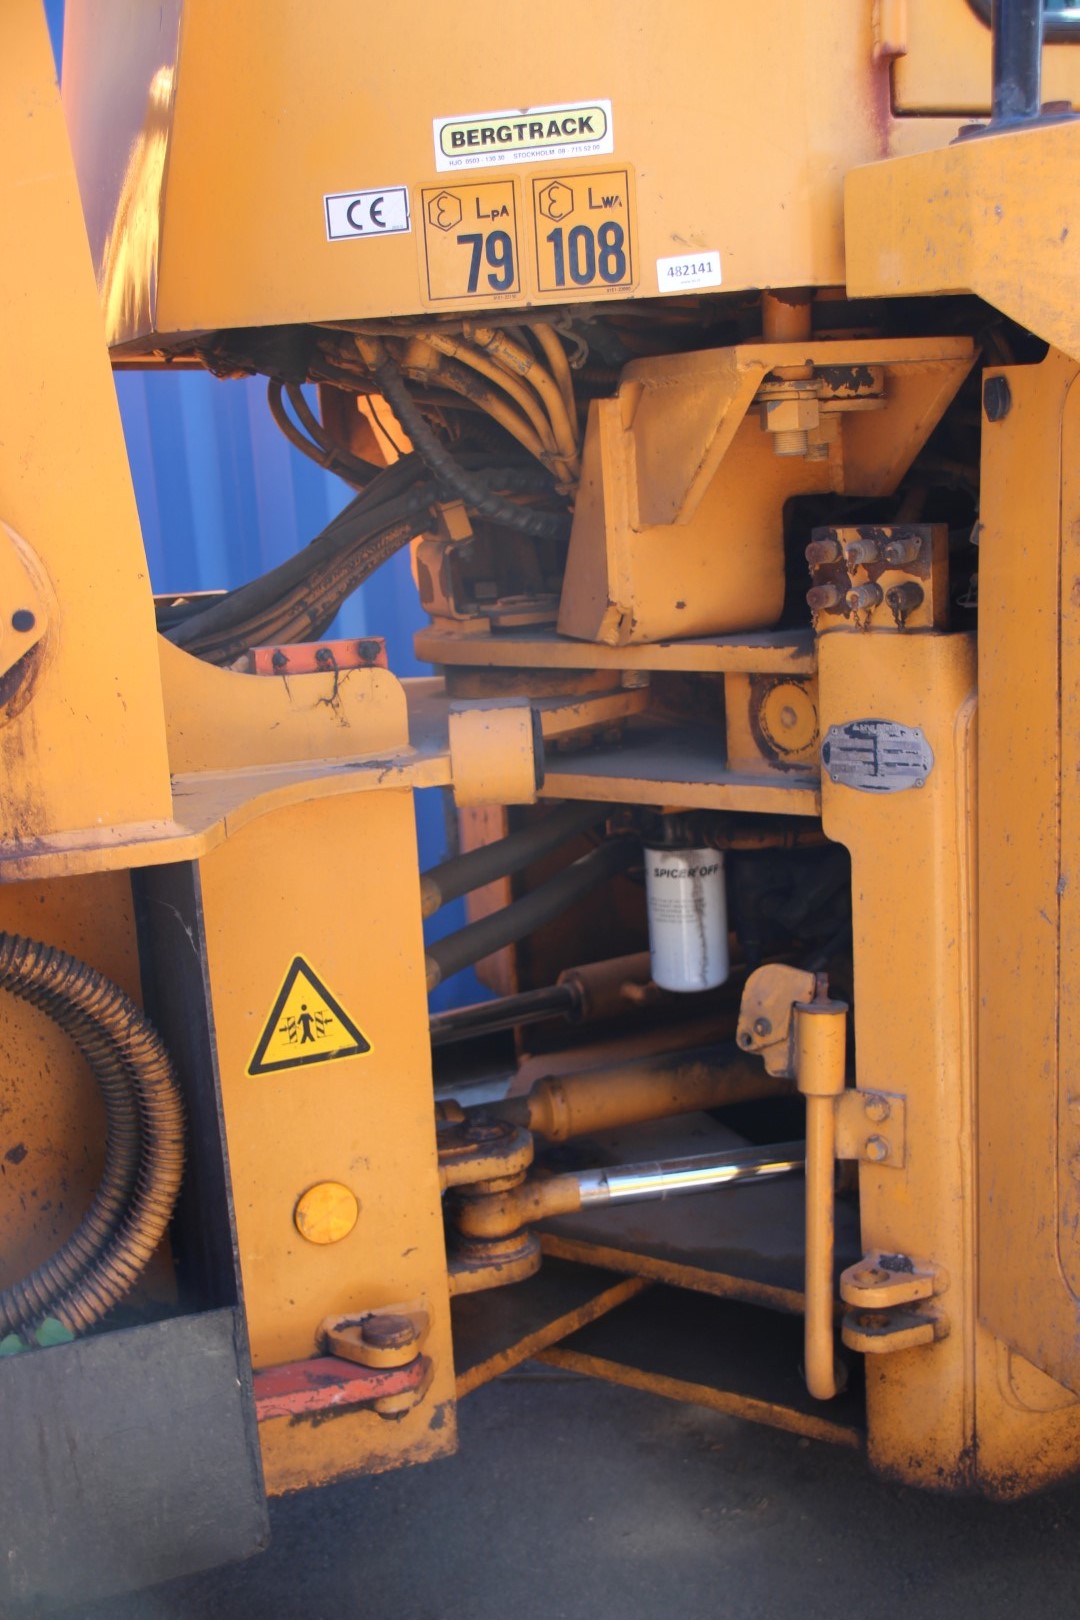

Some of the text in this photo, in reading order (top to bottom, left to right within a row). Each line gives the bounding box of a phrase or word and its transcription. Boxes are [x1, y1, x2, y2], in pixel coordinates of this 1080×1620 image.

[450, 116, 595, 148] BERGTRACK
[513, 149, 555, 159] STOCKHOLM
[346, 196, 386, 231] CE
[457, 230, 515, 293] 79
[546, 221, 627, 287] 108
[667, 261, 713, 278] 482141
